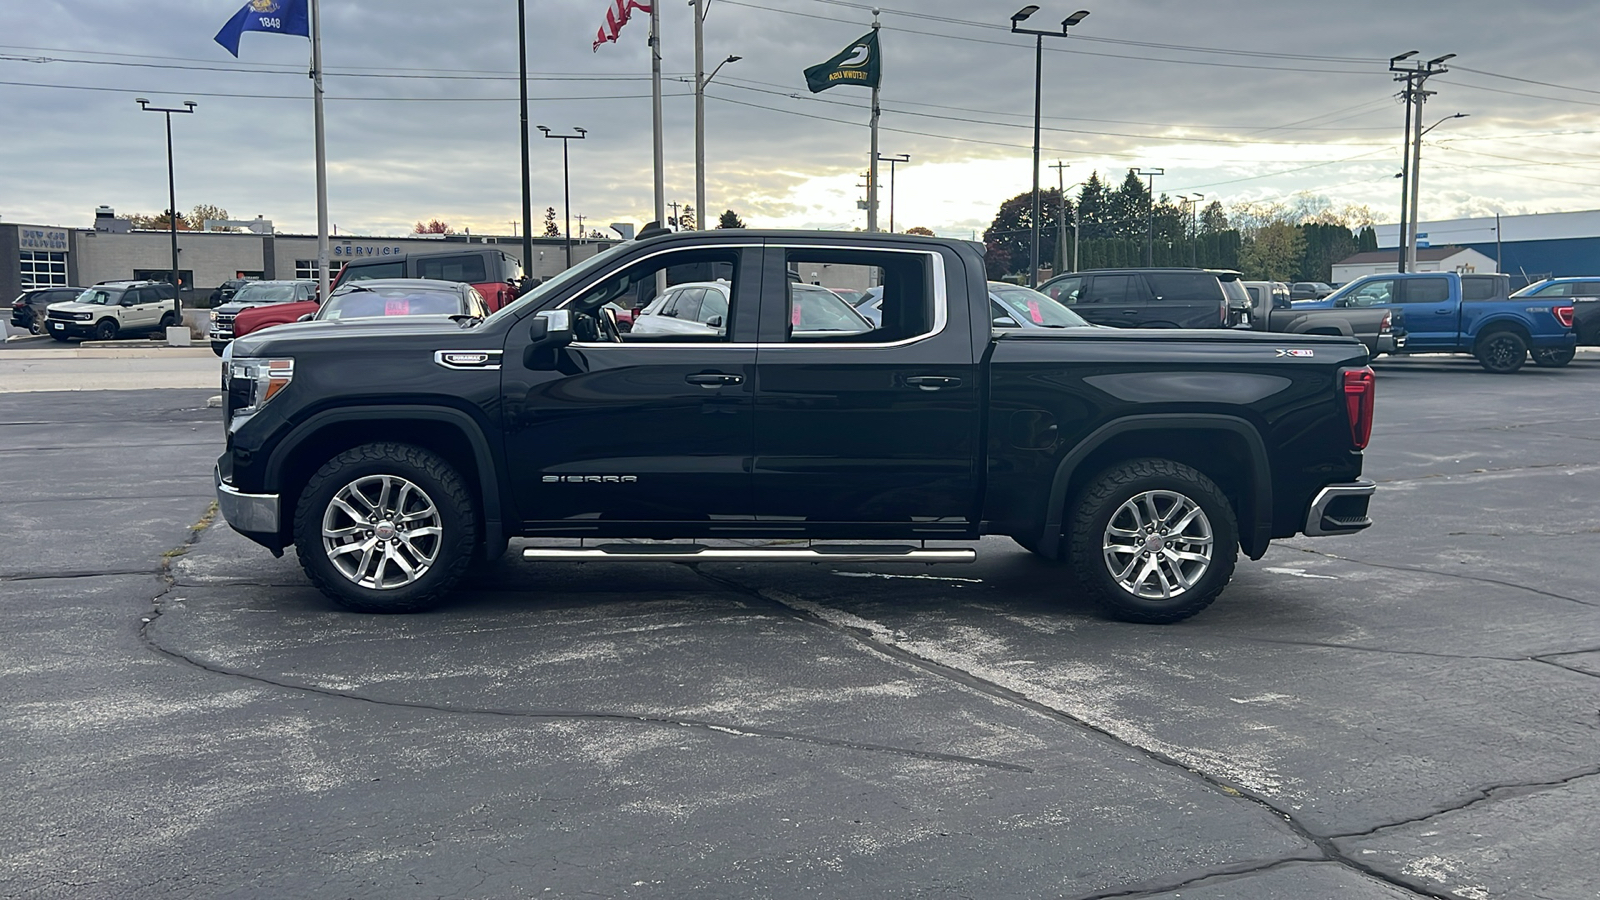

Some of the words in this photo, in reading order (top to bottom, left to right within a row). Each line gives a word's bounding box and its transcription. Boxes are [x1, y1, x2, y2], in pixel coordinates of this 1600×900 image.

[259, 17, 281, 29] 1848
[335, 246, 401, 255] SERVICE
[542, 475, 638, 483] SIERRA
